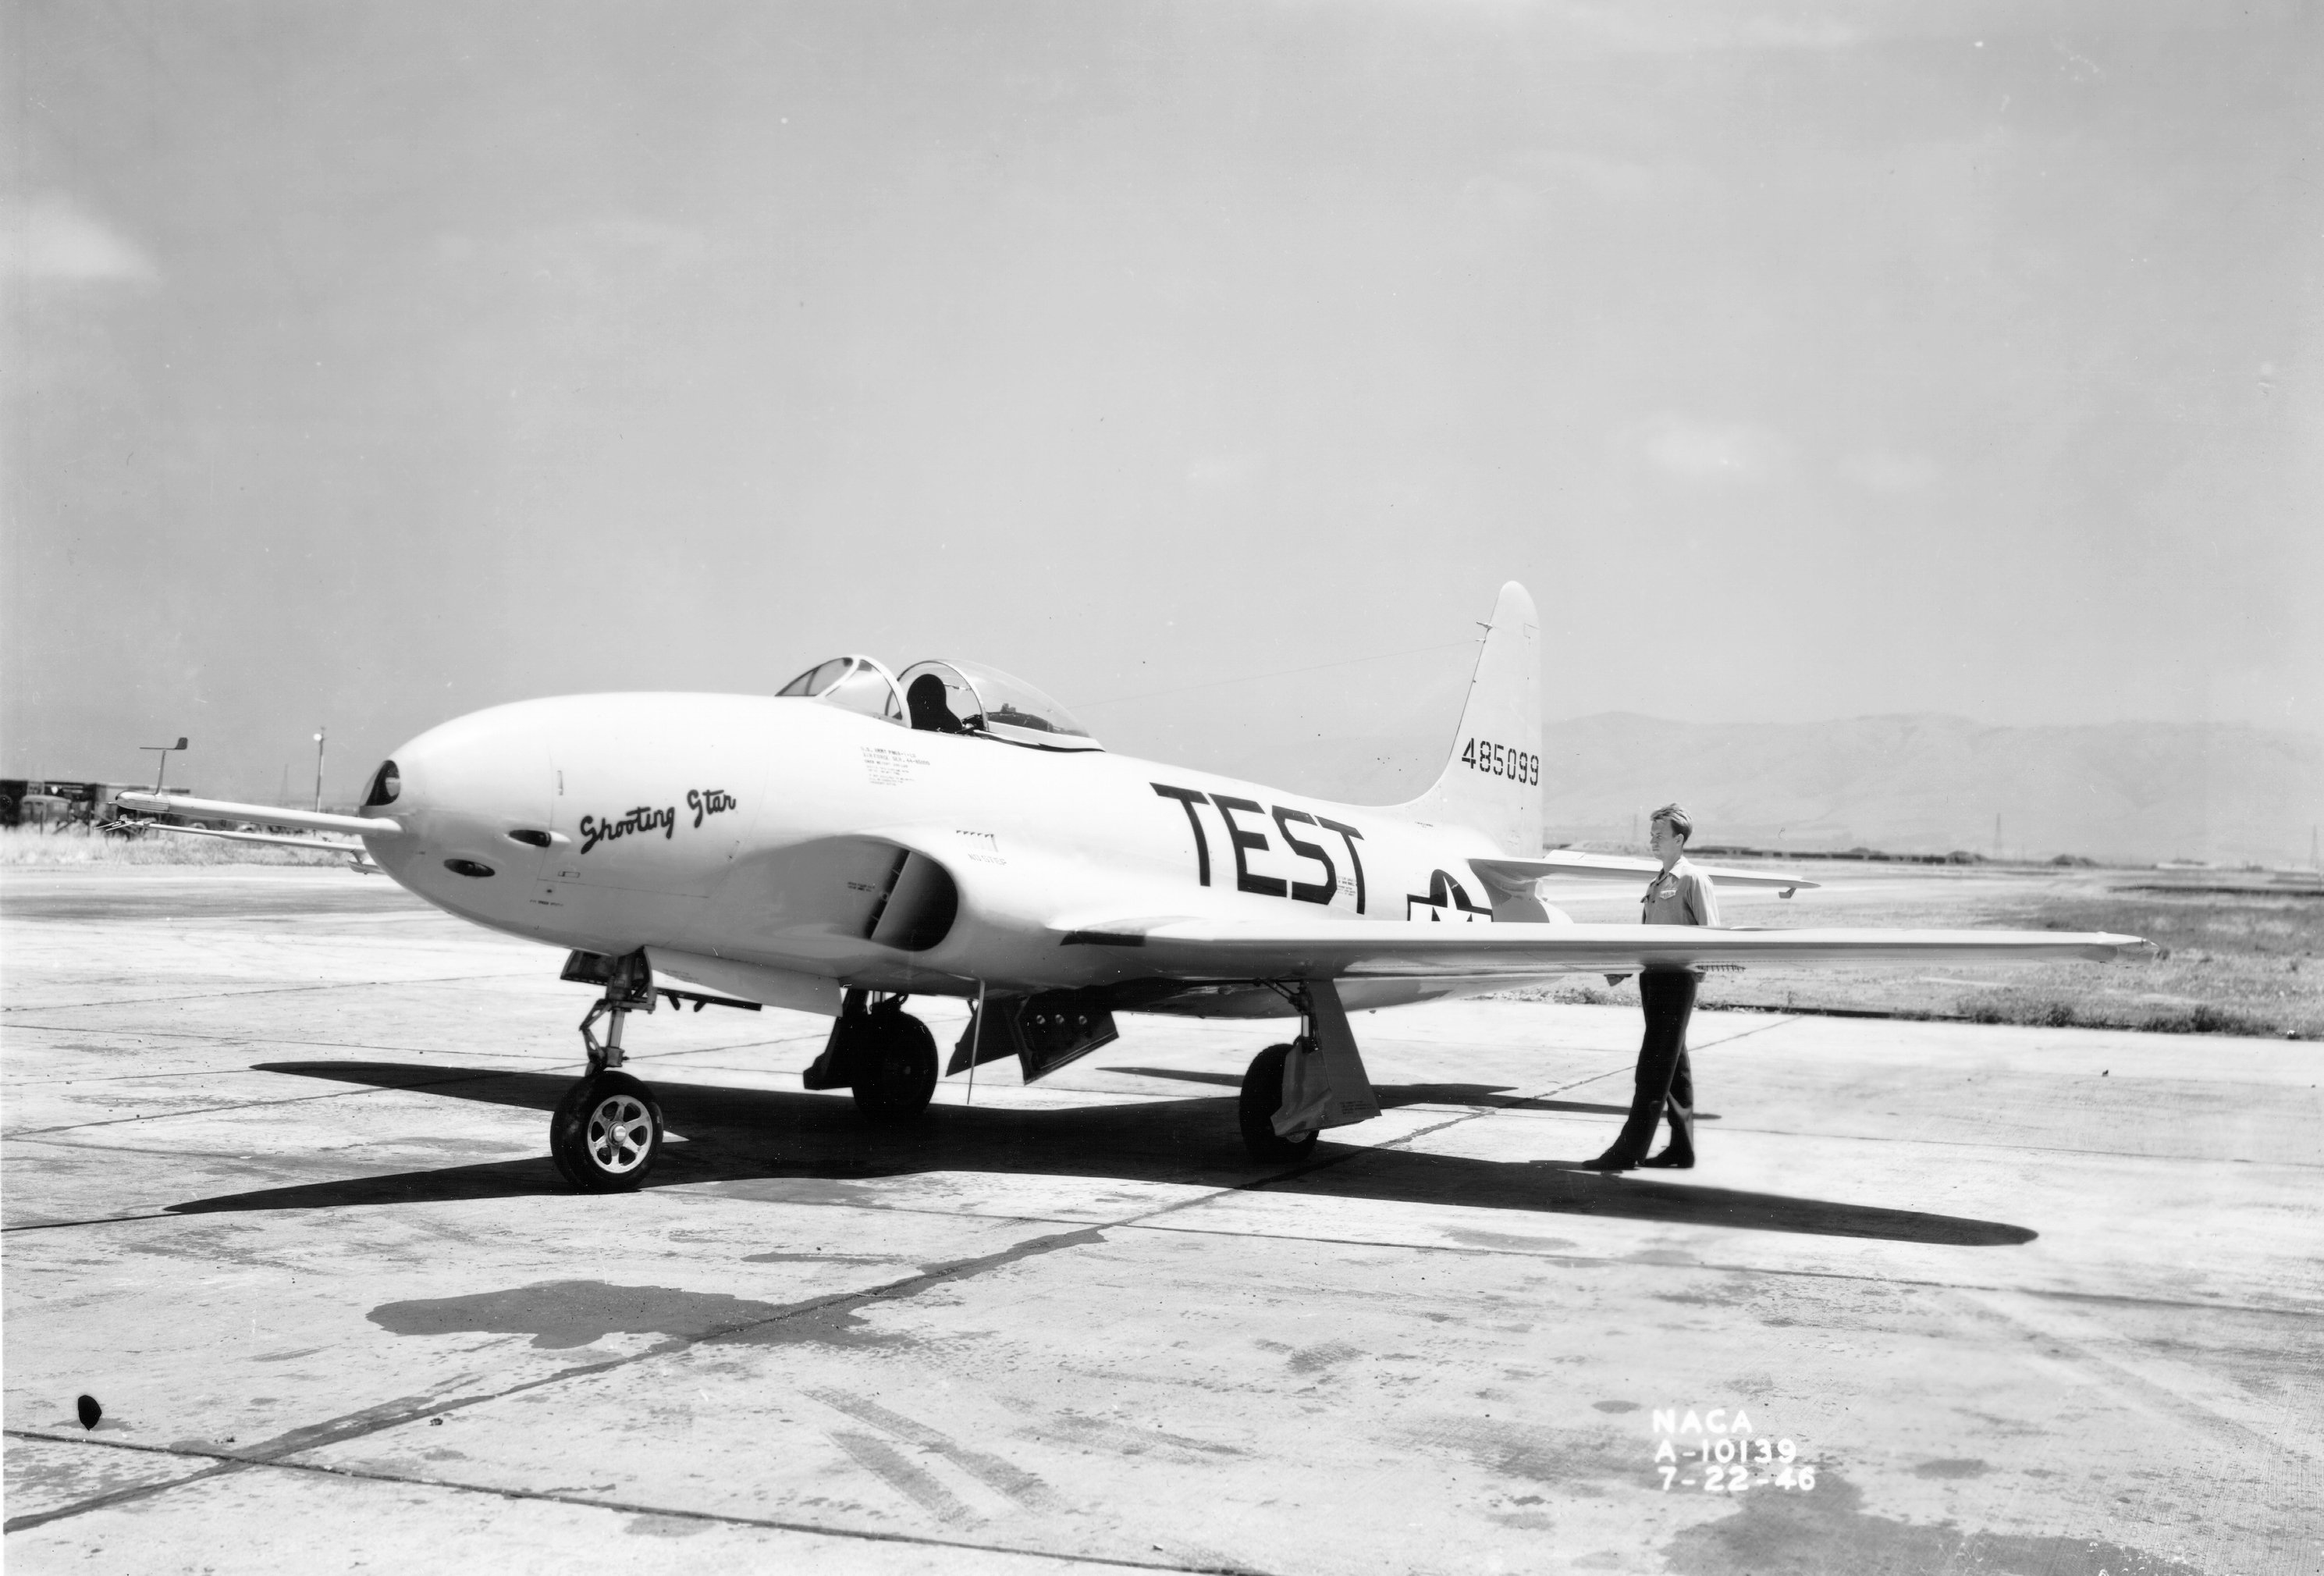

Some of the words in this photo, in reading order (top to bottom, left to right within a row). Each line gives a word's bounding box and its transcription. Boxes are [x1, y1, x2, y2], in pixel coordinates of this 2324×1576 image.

[1462, 738, 1539, 786] 485099
[580, 806, 675, 855] Shooting
[687, 789, 737, 828] Star
[1149, 781, 1365, 915] TEST
